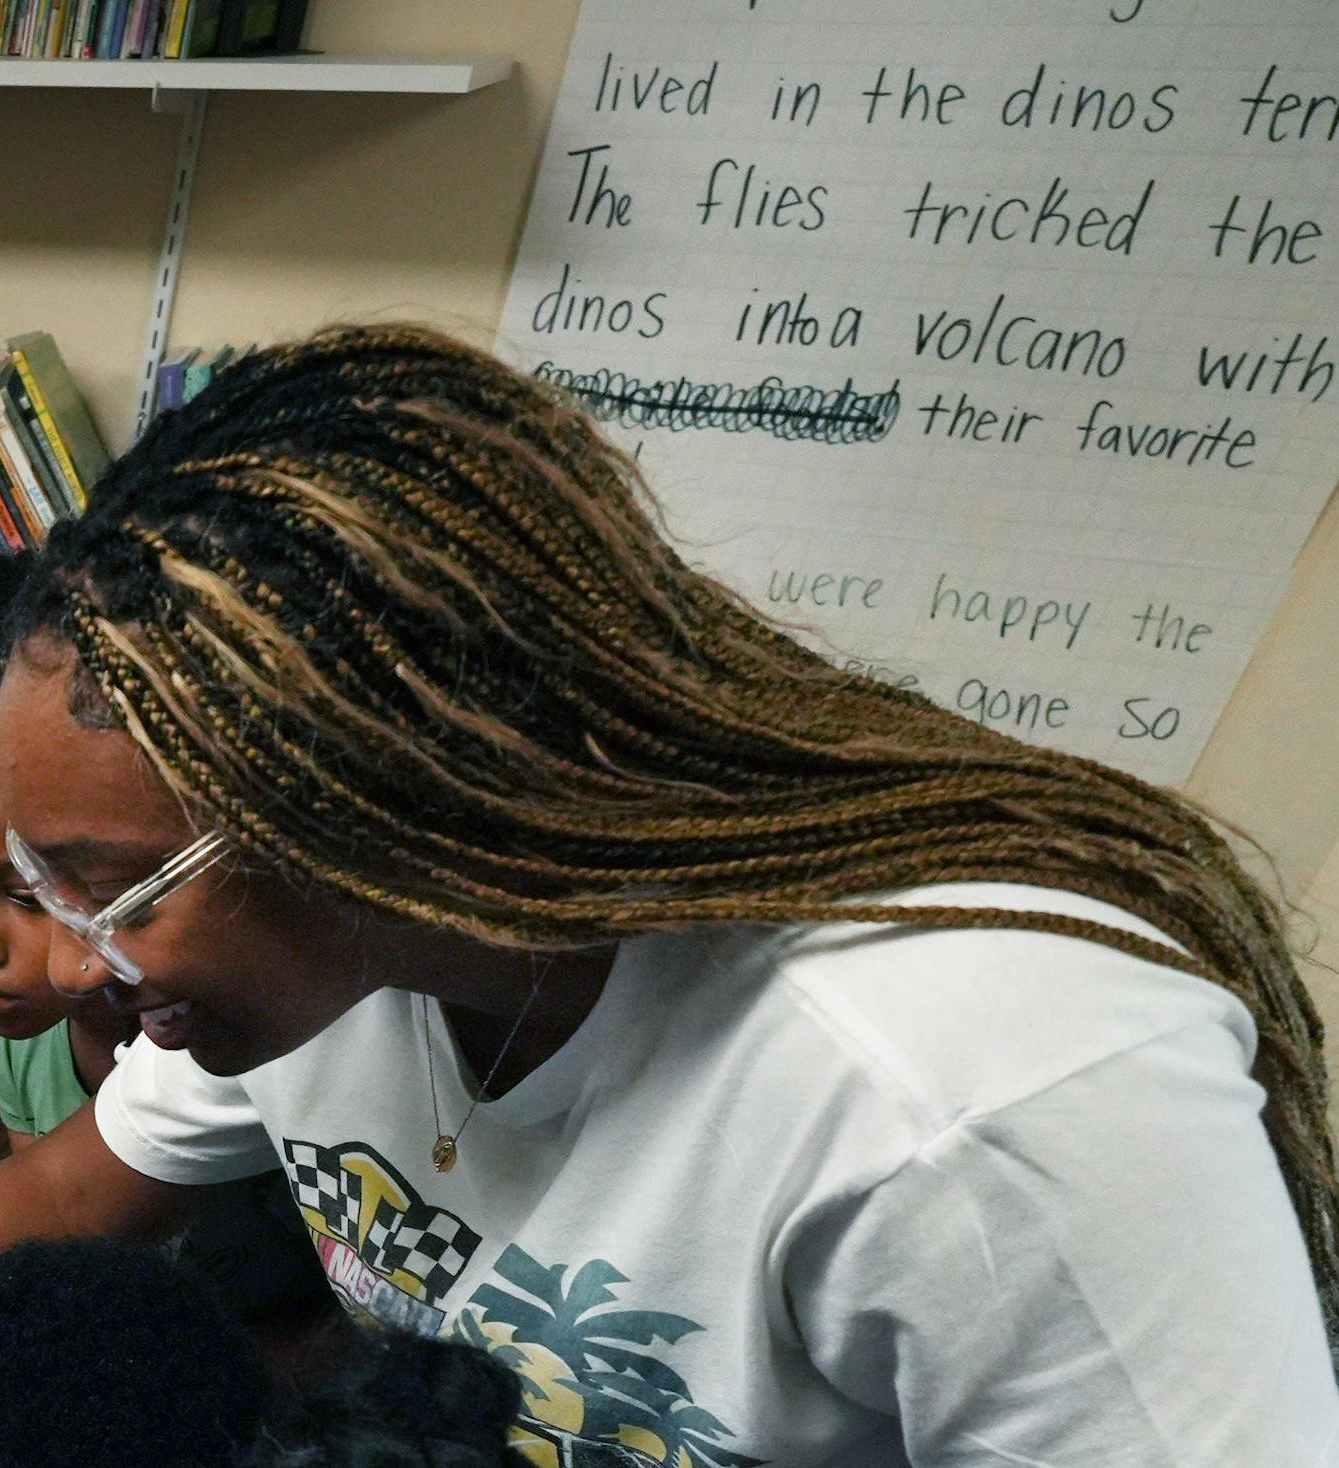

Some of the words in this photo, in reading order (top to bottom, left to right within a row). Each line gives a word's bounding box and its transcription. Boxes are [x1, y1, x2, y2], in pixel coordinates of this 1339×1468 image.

[595, 52, 718, 116] lived
[770, 75, 820, 129] in
[862, 65, 967, 128] the
[1000, 63, 1178, 135] dinos
[567, 143, 632, 229] The
[696, 159, 828, 231] flies
[905, 178, 1154, 256] tricked
[1208, 195, 1322, 266] the
[532, 264, 667, 339] dinos
[915, 294, 1128, 378] volcano
[1198, 335, 1335, 403] with
[919, 394, 1042, 446] their
[1076, 401, 1258, 469] favorite
[768, 567, 884, 611] were
[929, 571, 1092, 651] happy
[1131, 603, 1212, 654] the
[955, 677, 1071, 732] gone
